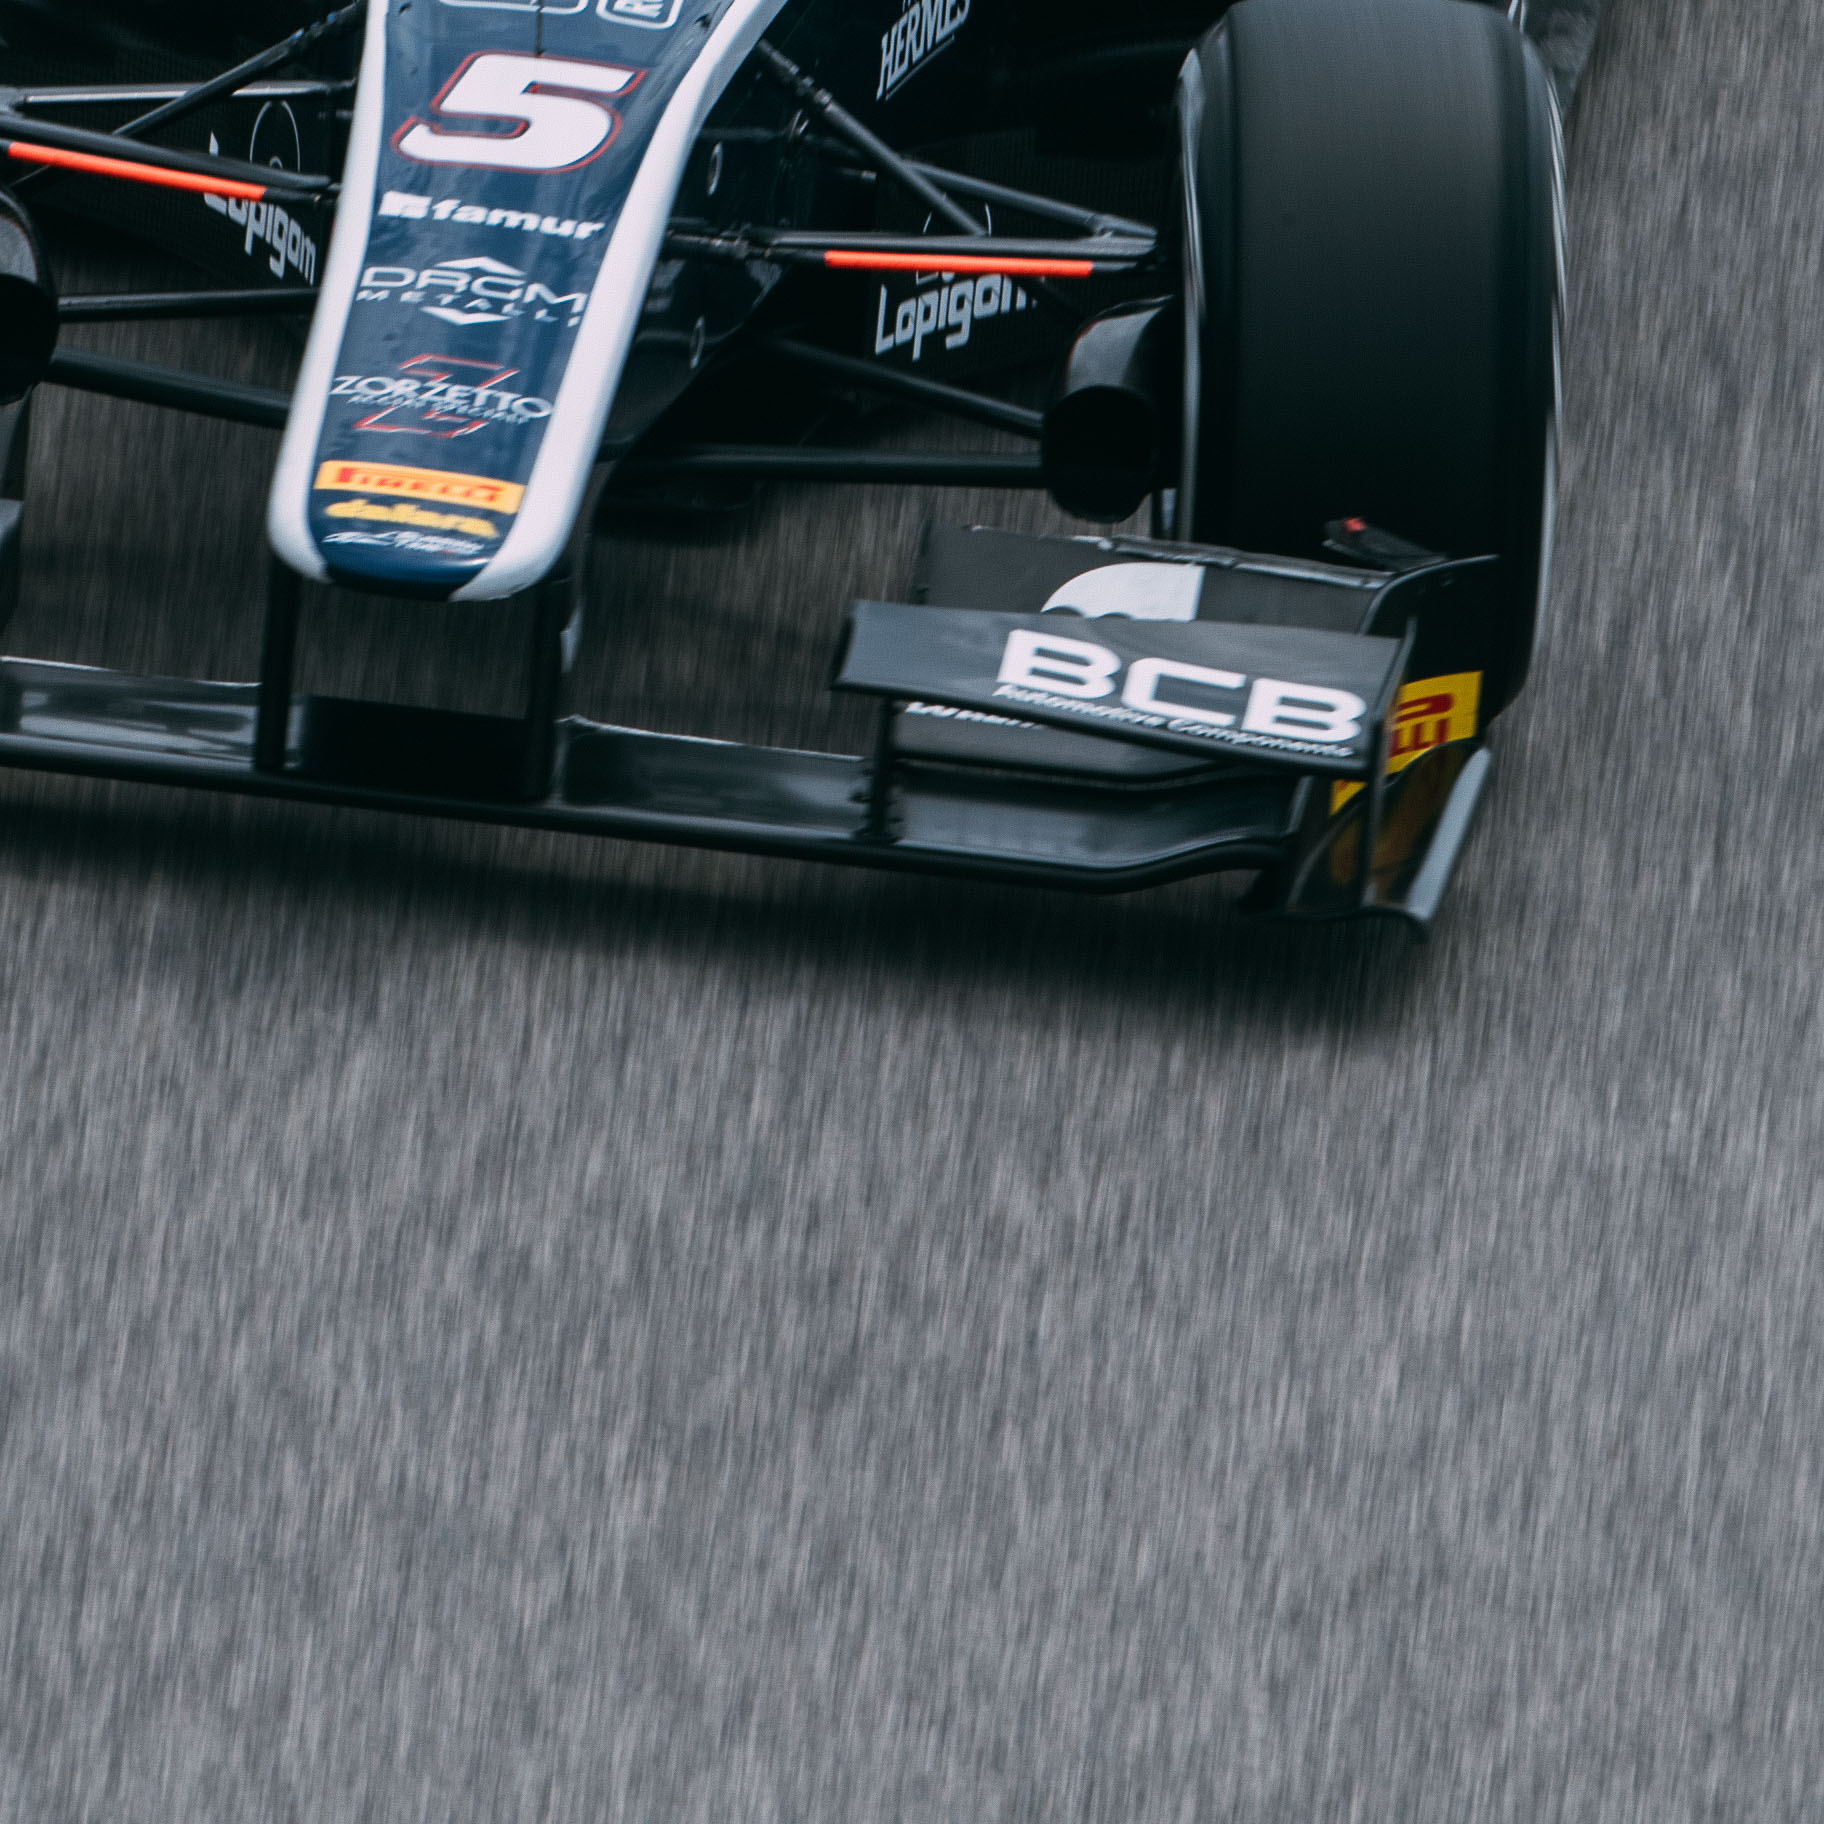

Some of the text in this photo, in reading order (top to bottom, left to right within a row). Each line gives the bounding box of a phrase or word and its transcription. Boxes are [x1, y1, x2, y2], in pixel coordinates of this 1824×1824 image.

[390, 49, 647, 174] 5
[330, 375, 554, 420] ZORZETTO
[998, 629, 1367, 743] BCB
